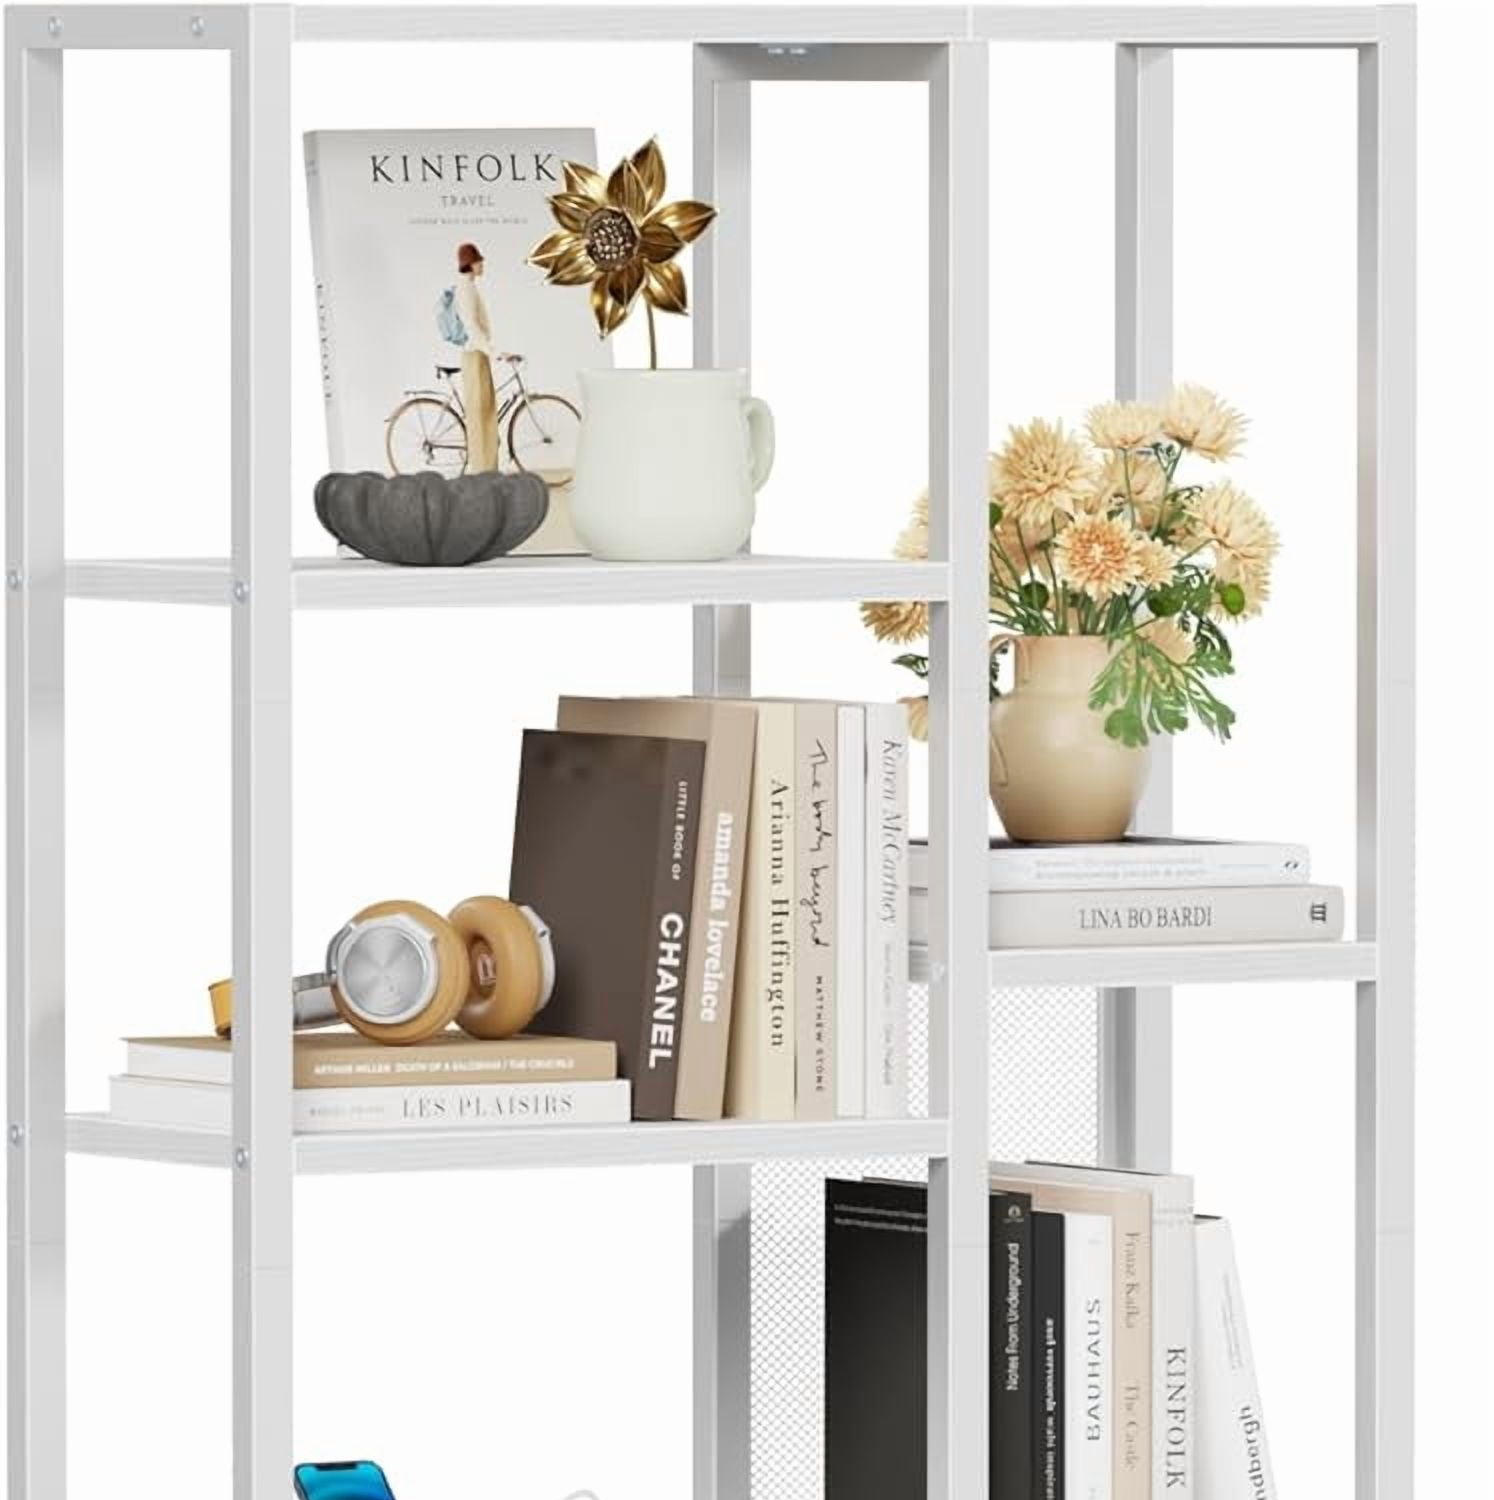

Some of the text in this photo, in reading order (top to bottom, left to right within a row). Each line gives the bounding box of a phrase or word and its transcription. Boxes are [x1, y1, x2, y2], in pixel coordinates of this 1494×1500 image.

[371, 153, 557, 183] KINFOLK
[440, 195, 496, 208] TRAVEL
[882, 739, 903, 801] Karen
[671, 781, 688, 880] LITTLE BOOK OF
[800, 738, 832, 946] The body beyond
[880, 810, 902, 922] McCartney
[700, 812, 734, 1023] amanda lovelace
[767, 778, 791, 1046] Arianna Huffington
[1079, 904, 1212, 929] LINA BO BARDI
[649, 912, 684, 1069] CHANEL
[816, 976, 825, 1091] MATTHEW STONE
[403, 1097, 446, 1118] LES
[459, 1094, 573, 1118] PLAISIRS
[1006, 1243, 1022, 1322] Underground
[1125, 1232, 1140, 1329] Franz Kafka
[1006, 1355, 1019, 1391] Notes
[1087, 1298, 1101, 1441] BAUHAUS
[1167, 1348, 1186, 1488] KINFOLK
